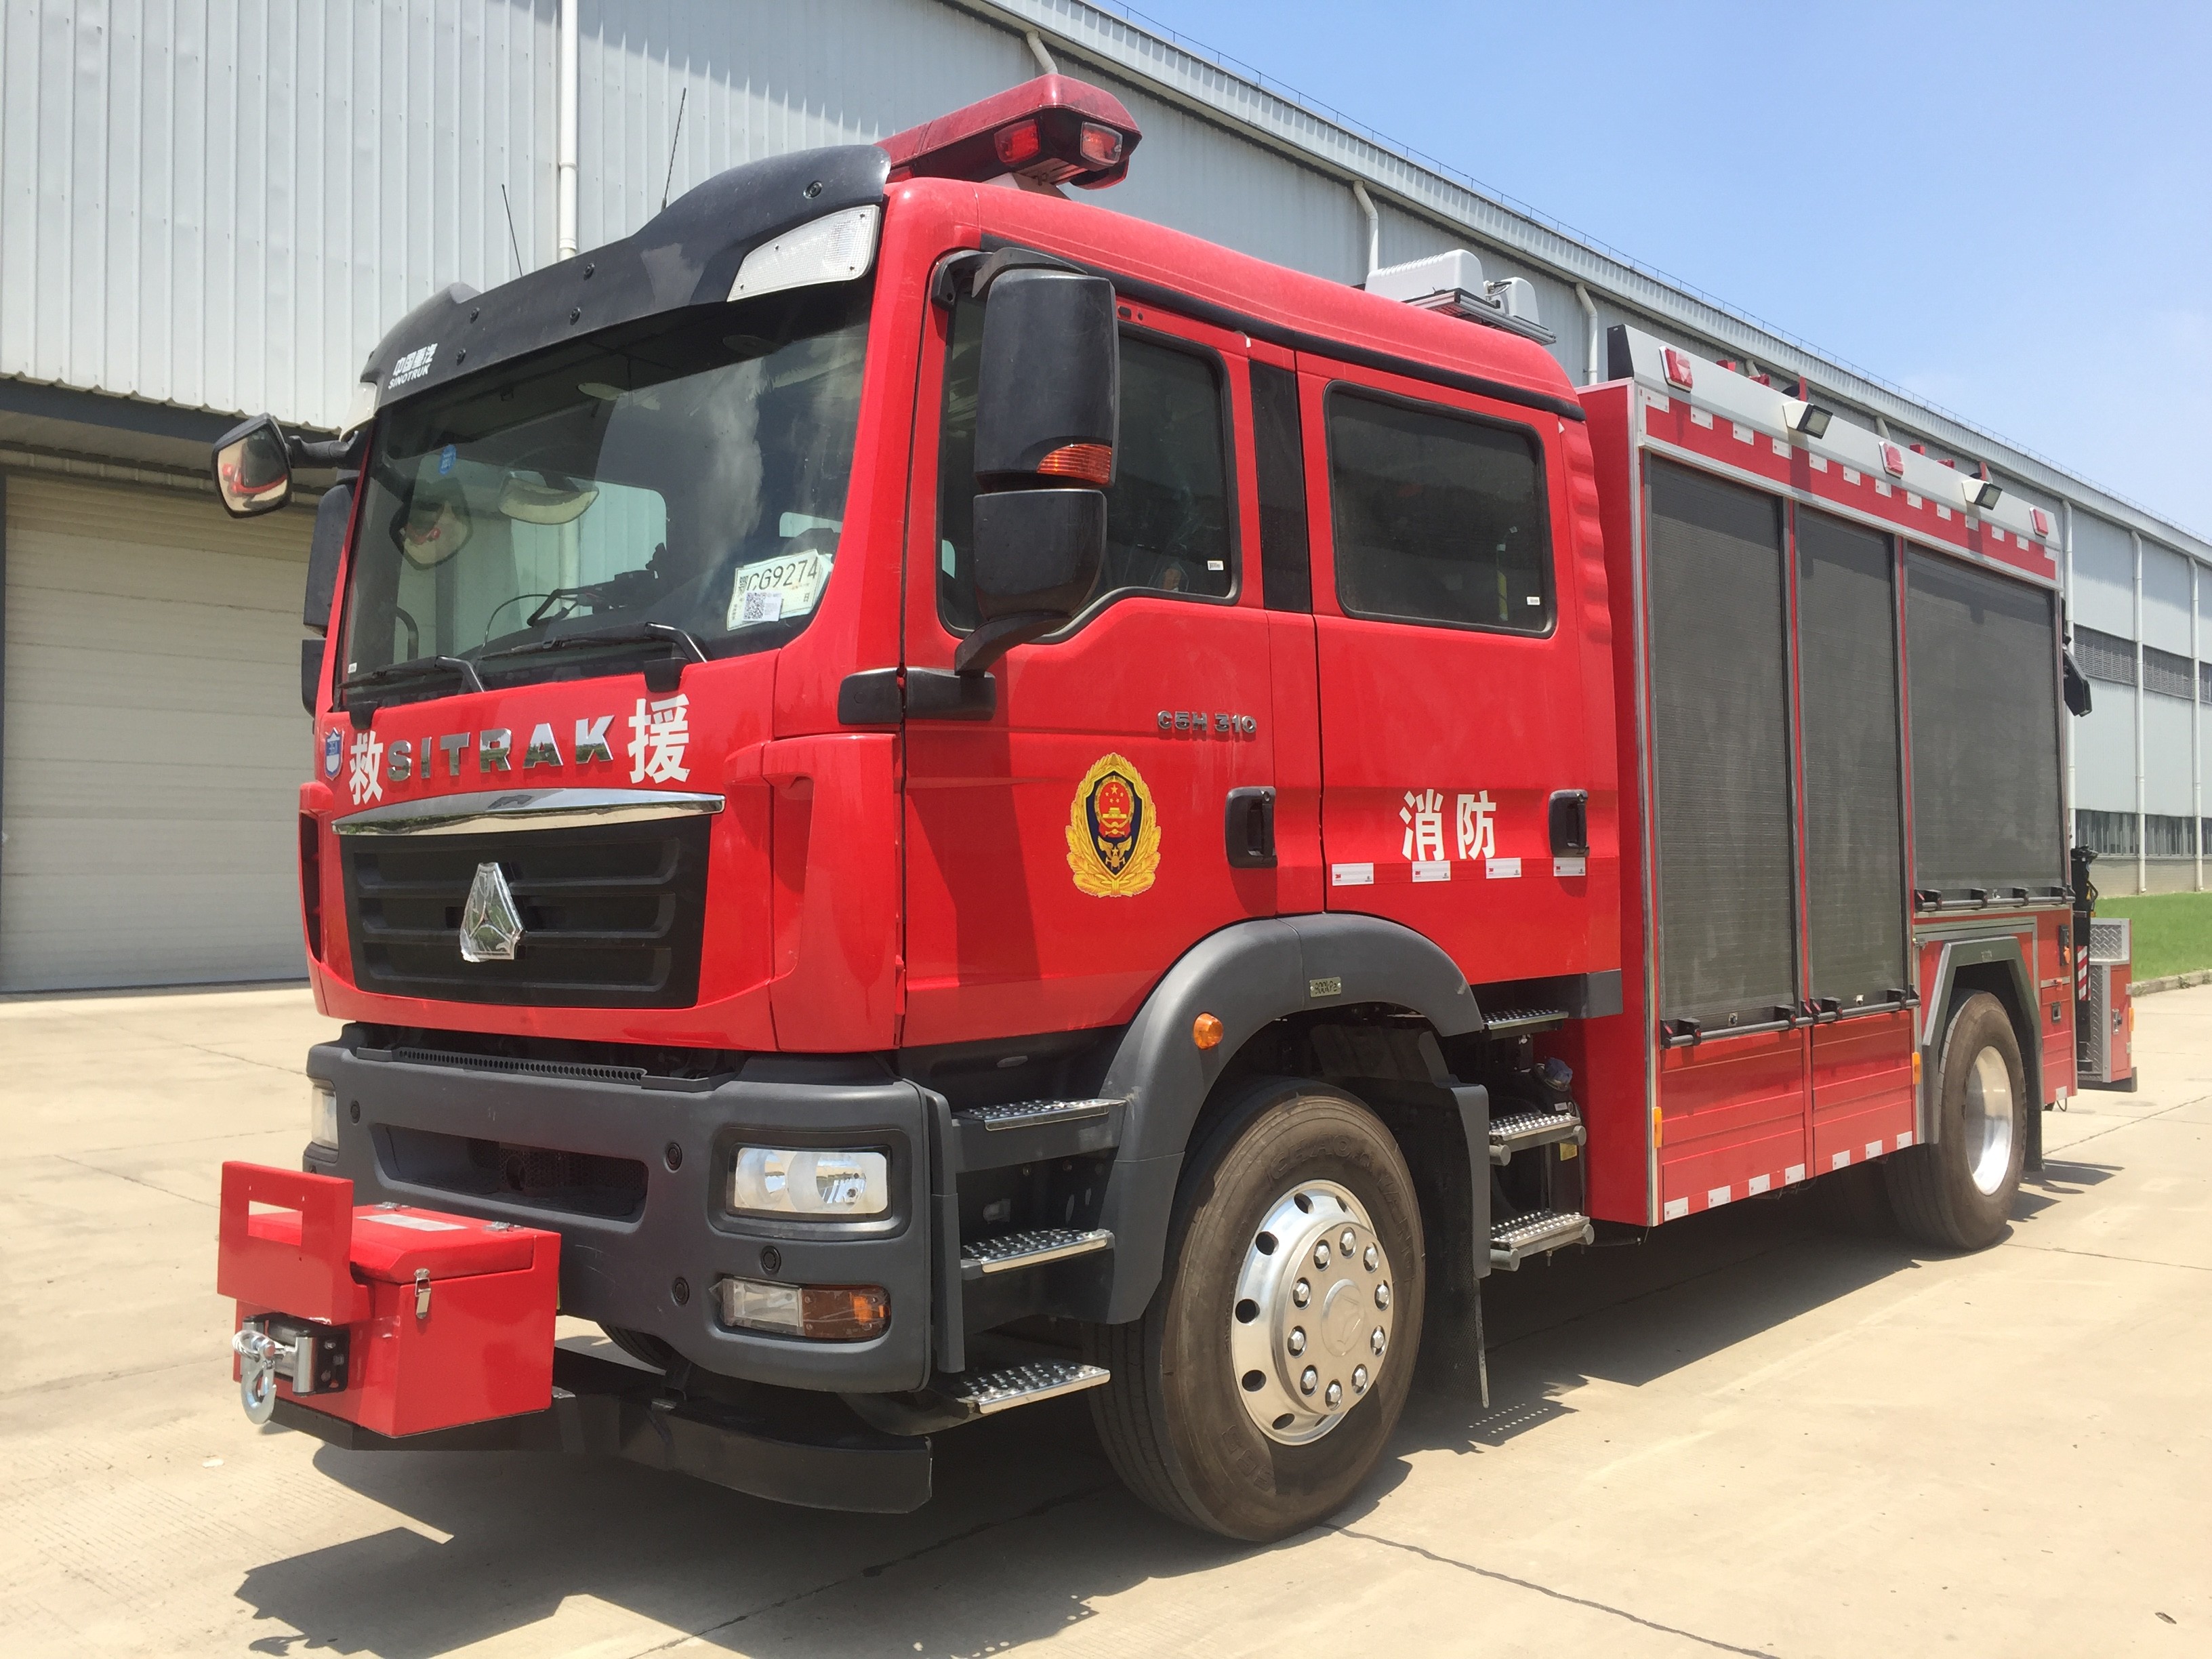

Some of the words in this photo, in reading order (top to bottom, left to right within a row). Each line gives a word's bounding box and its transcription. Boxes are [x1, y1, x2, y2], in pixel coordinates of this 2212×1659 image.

[388, 363, 430, 390] SINOTRUK
[387, 715, 615, 781] SITRAK
[628, 693, 690, 784] 援
[1158, 711, 1208, 731] C5H
[1214, 713, 1257, 733] 310
[348, 730, 384, 805] 救
[1399, 789, 1496, 861] 消防
